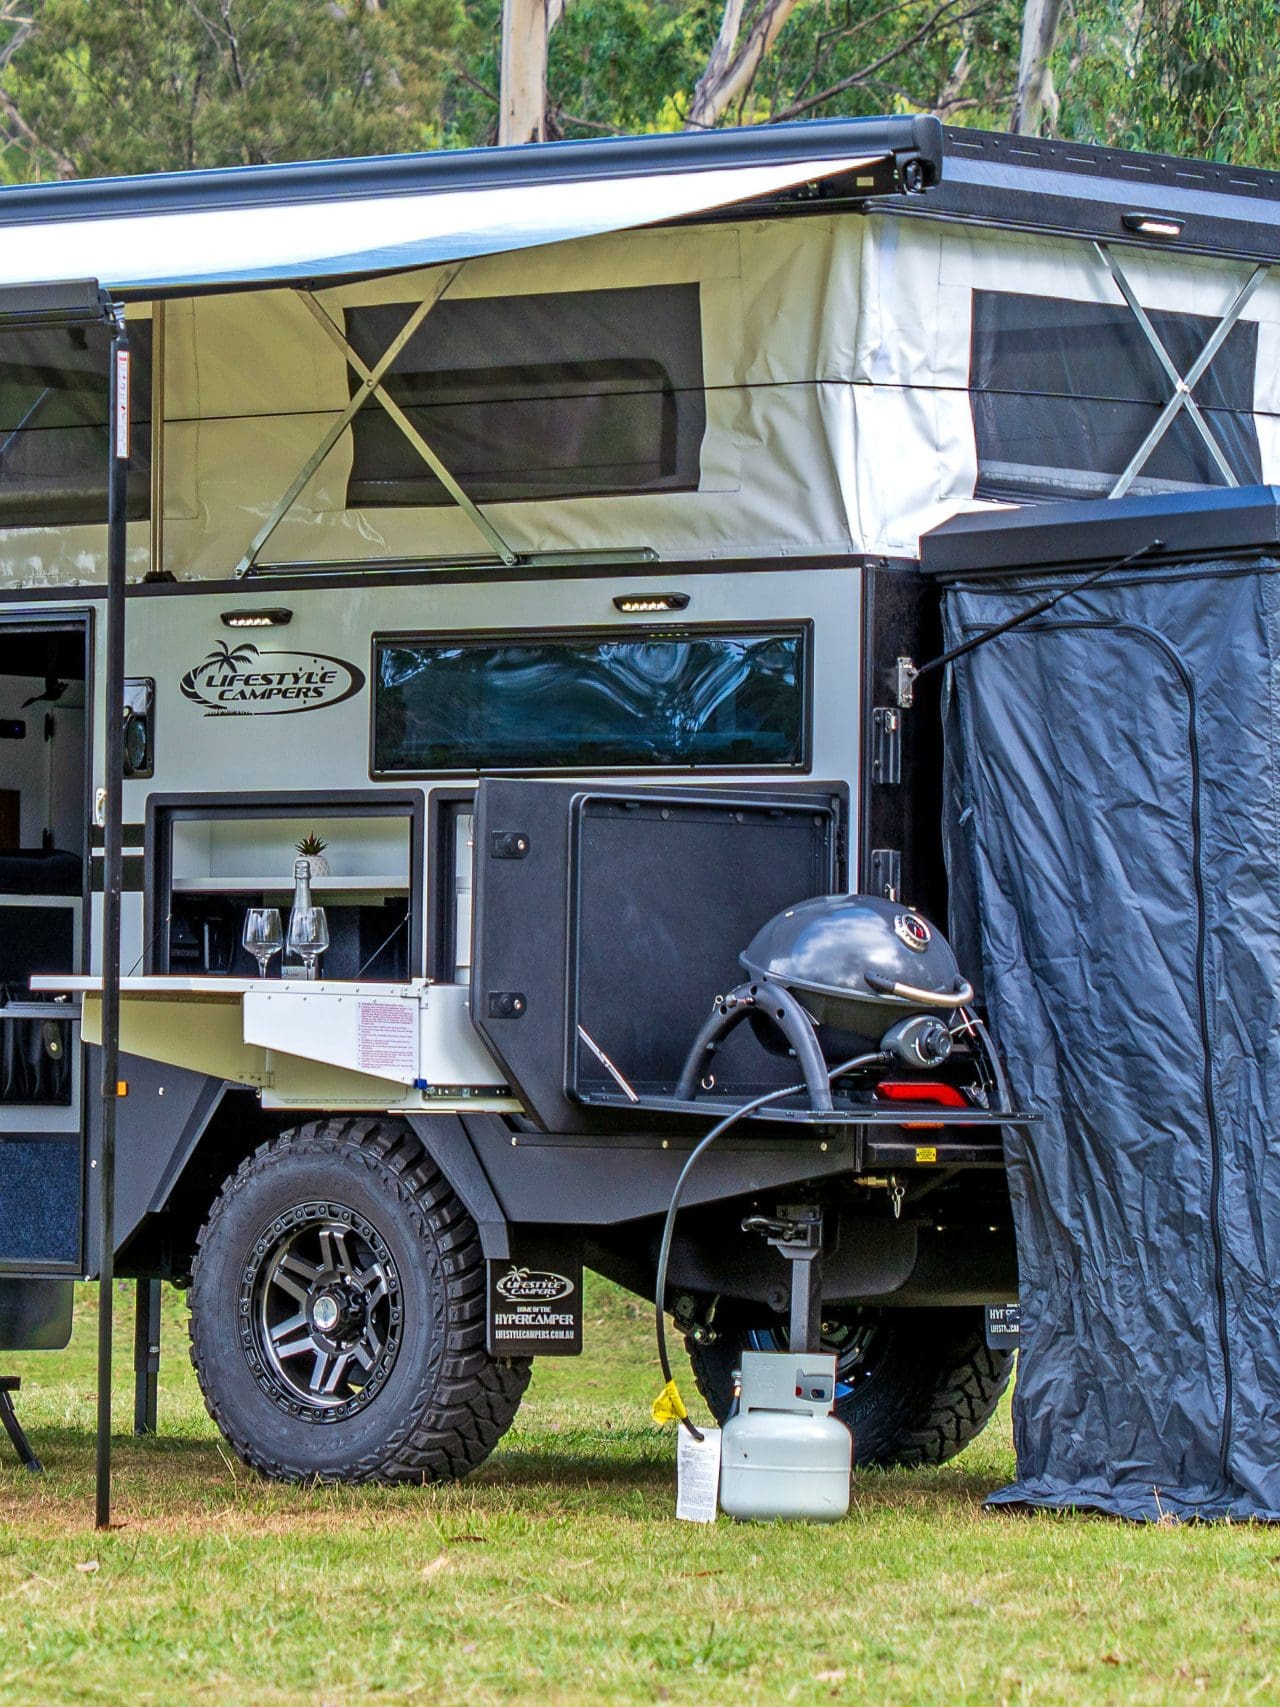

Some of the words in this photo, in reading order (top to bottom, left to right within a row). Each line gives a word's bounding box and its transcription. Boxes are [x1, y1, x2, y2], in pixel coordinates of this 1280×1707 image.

[205, 671, 338, 688] LIFESTYLE
[218, 686, 326, 701] CAMPERS
[506, 1281, 565, 1289] LIFESTYLE
[495, 1314, 574, 1325] HYPERCAMPER
[495, 1330, 575, 1339] LIFESTYLECAMPERS.COM.AU
